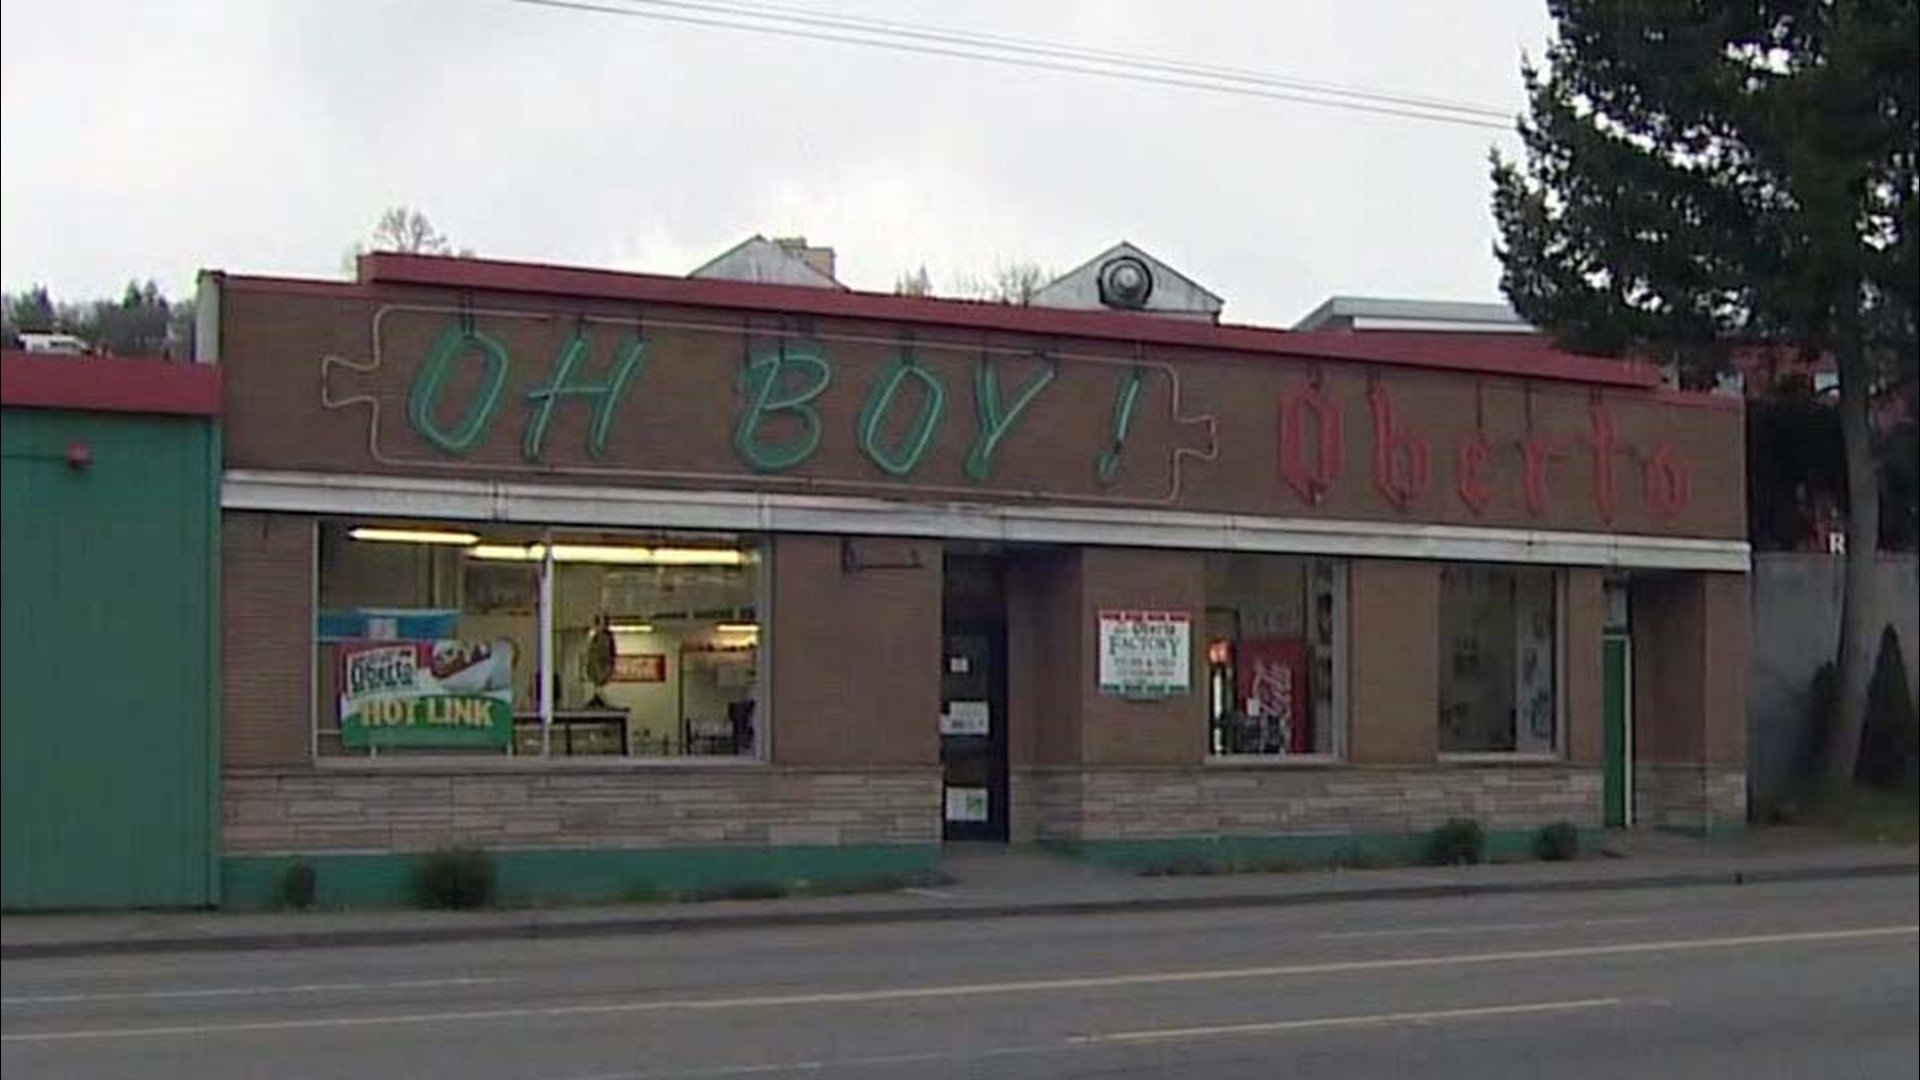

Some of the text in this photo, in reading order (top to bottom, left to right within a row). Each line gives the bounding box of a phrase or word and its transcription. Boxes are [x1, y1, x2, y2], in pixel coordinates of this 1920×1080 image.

[410, 329, 646, 462] OH
[735, 348, 1056, 480] BOY
[1277, 377, 1693, 527] Oberto
[361, 699, 493, 726] HOT LINK
